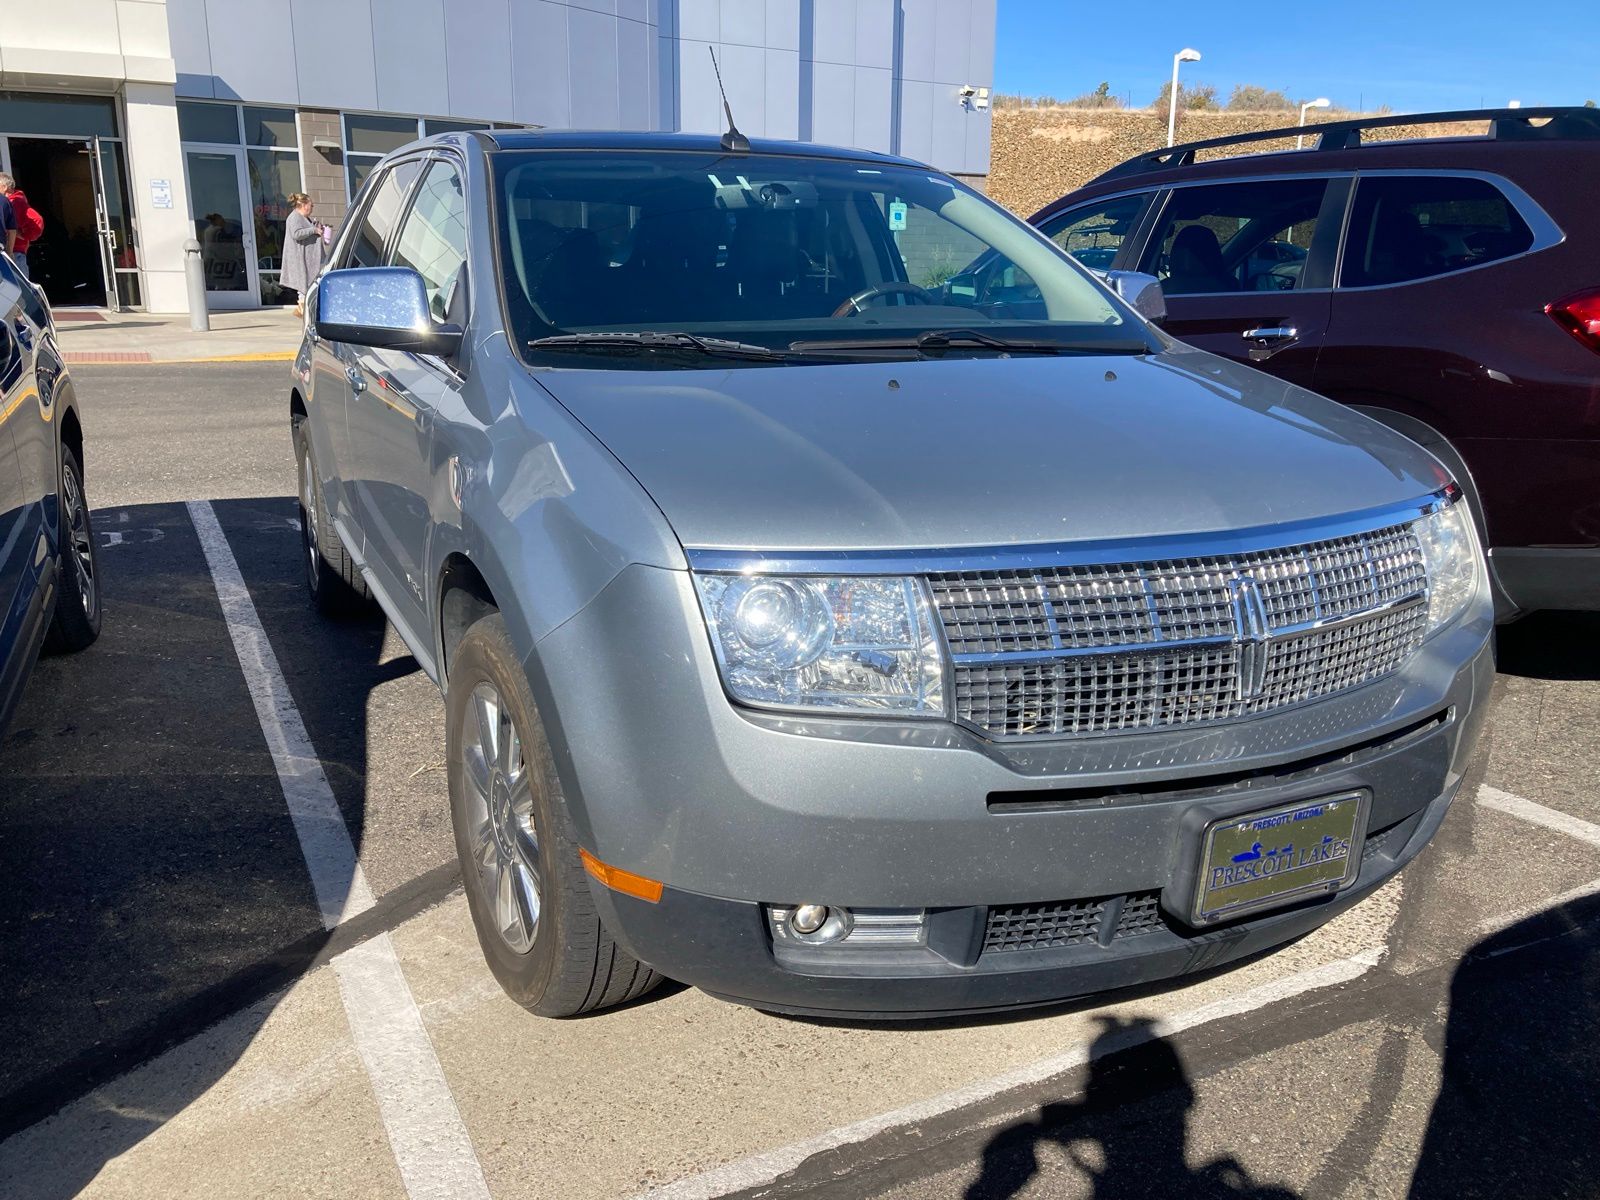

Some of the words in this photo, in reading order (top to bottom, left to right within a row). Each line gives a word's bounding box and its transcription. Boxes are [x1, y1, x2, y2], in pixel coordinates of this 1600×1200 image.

[255, 204, 288, 217] OPEN
[1293, 807, 1324, 821] ARIZONA
[1211, 851, 1294, 888] PRESCOTT
[1299, 838, 1350, 867] LAKES
